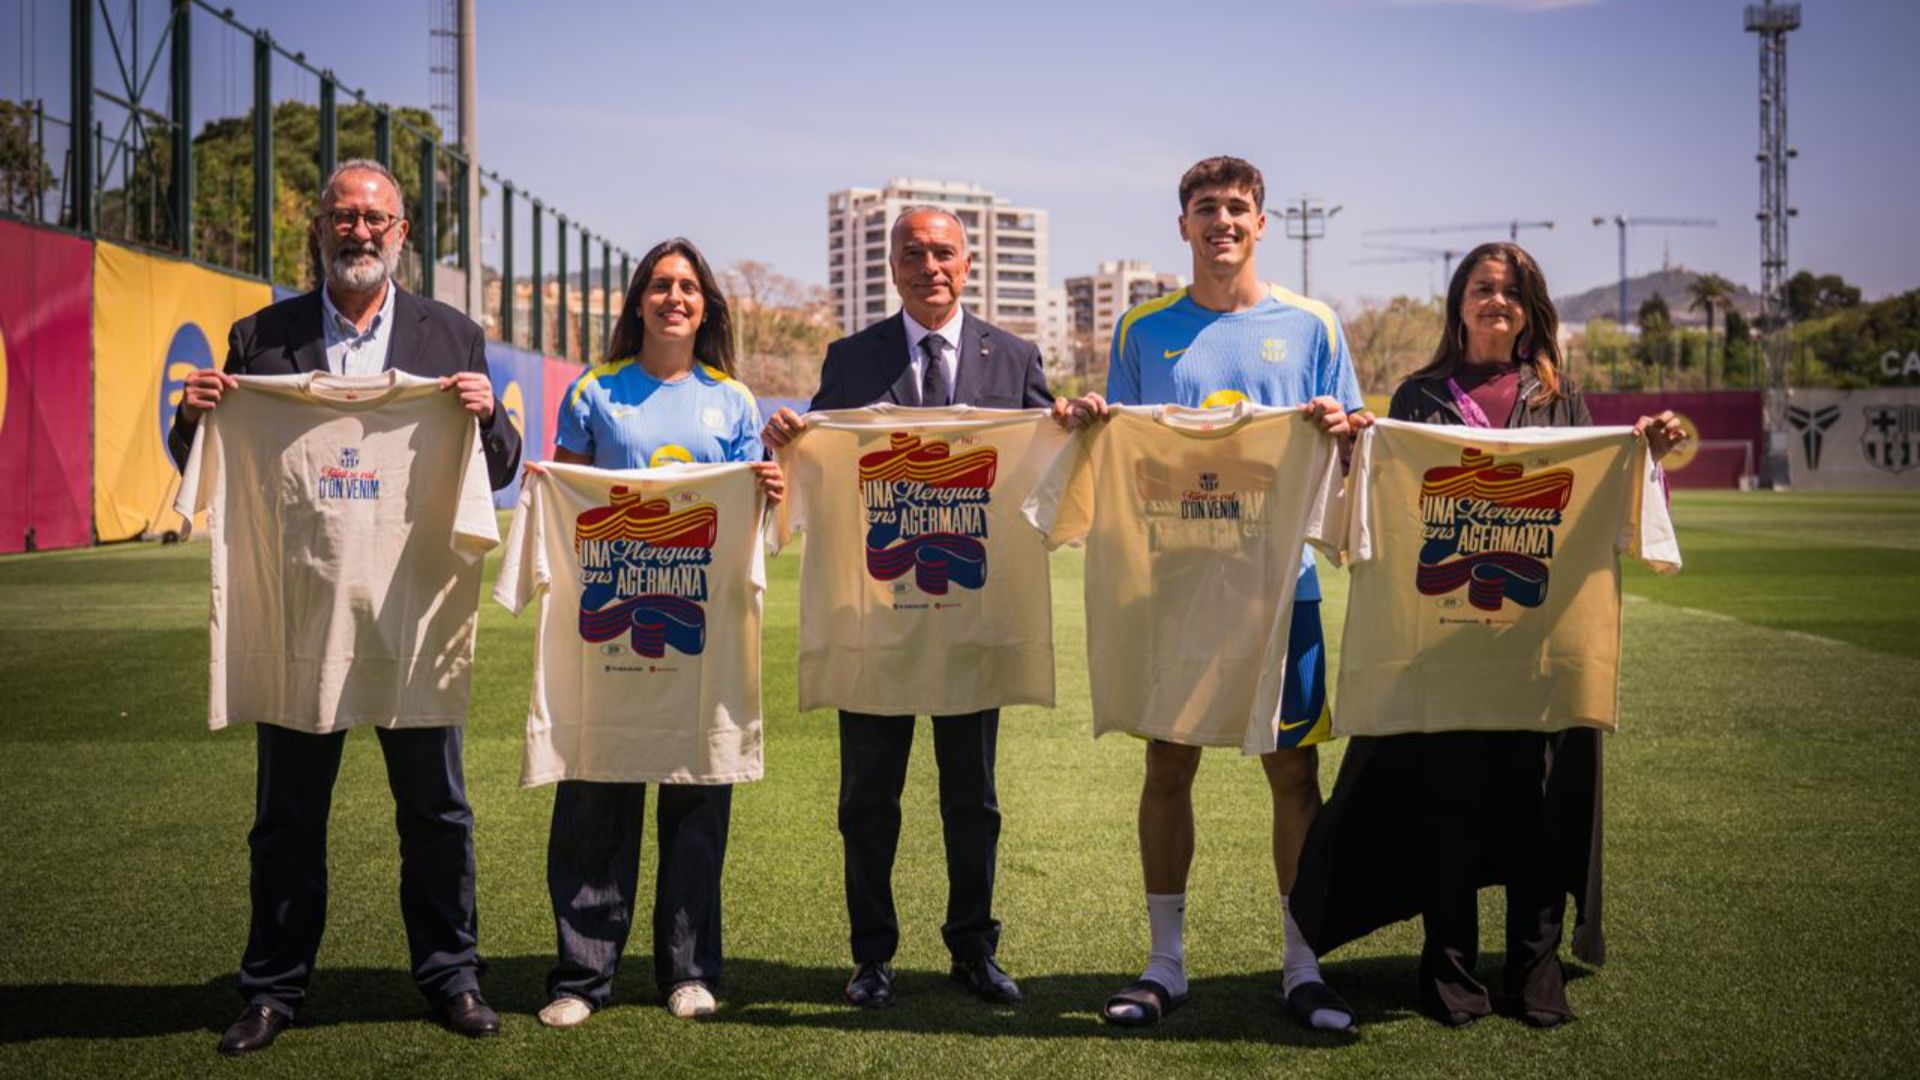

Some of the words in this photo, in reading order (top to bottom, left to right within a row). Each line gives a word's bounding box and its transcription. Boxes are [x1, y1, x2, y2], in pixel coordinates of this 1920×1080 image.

[319, 477, 343, 499] D'ON
[345, 478, 380, 500] VENIM
[863, 480, 894, 508] UNA
[893, 479, 984, 506] Llengua
[866, 510, 897, 525] ens
[900, 507, 982, 535] AGERMANA
[1181, 500, 1206, 520] D'ON
[1207, 500, 1241, 520] VENIM
[1422, 496, 1456, 525] UNA
[1455, 498, 1557, 525] Llengua
[580, 539, 611, 568] UNA
[611, 539, 705, 566] Llengua
[1421, 525, 1456, 540] ens
[1456, 525, 1548, 554] AGERMANA
[581, 570, 613, 585] ens
[616, 568, 702, 597] AGERMANA
